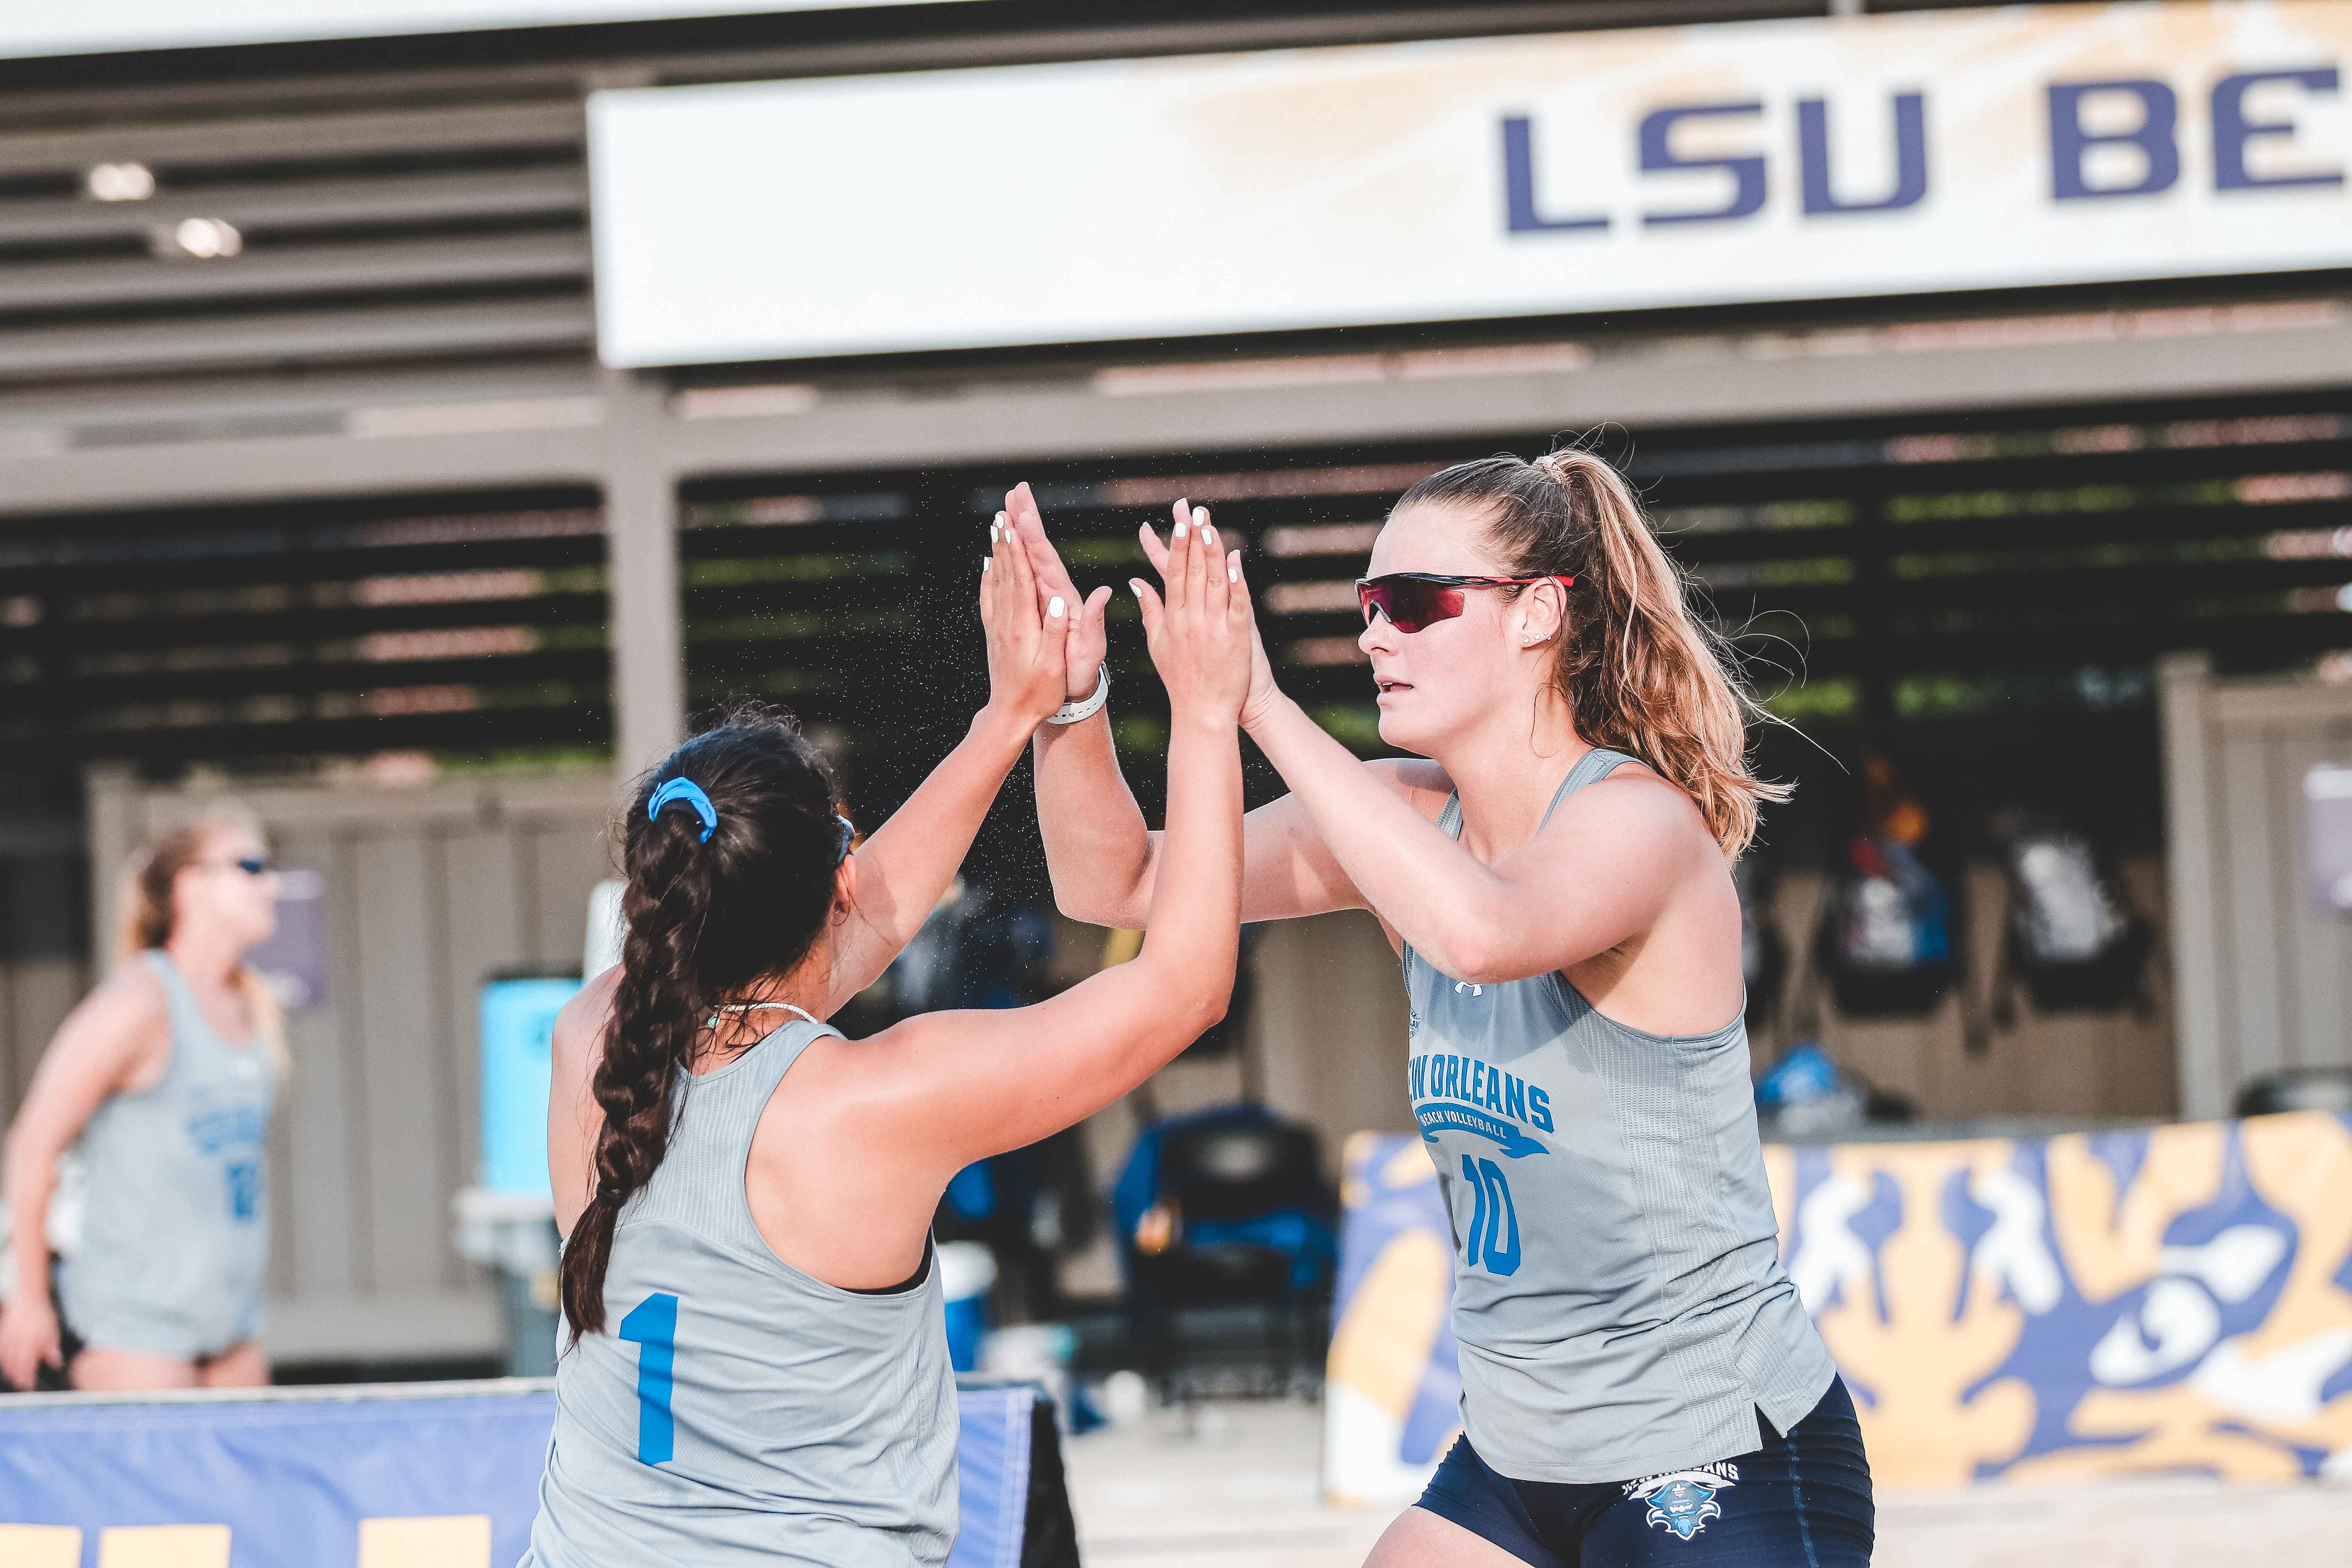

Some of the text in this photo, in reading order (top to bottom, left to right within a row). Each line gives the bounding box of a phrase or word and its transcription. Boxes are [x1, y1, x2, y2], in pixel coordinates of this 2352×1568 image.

[1501, 67, 2343, 234] LSU BE
[1419, 1110, 1506, 1139] BEACH VOLLEYBALL
[1431, 1054, 1555, 1134] ORLEANS
[1462, 1154, 1521, 1277] 10
[619, 1292, 679, 1466] 1
